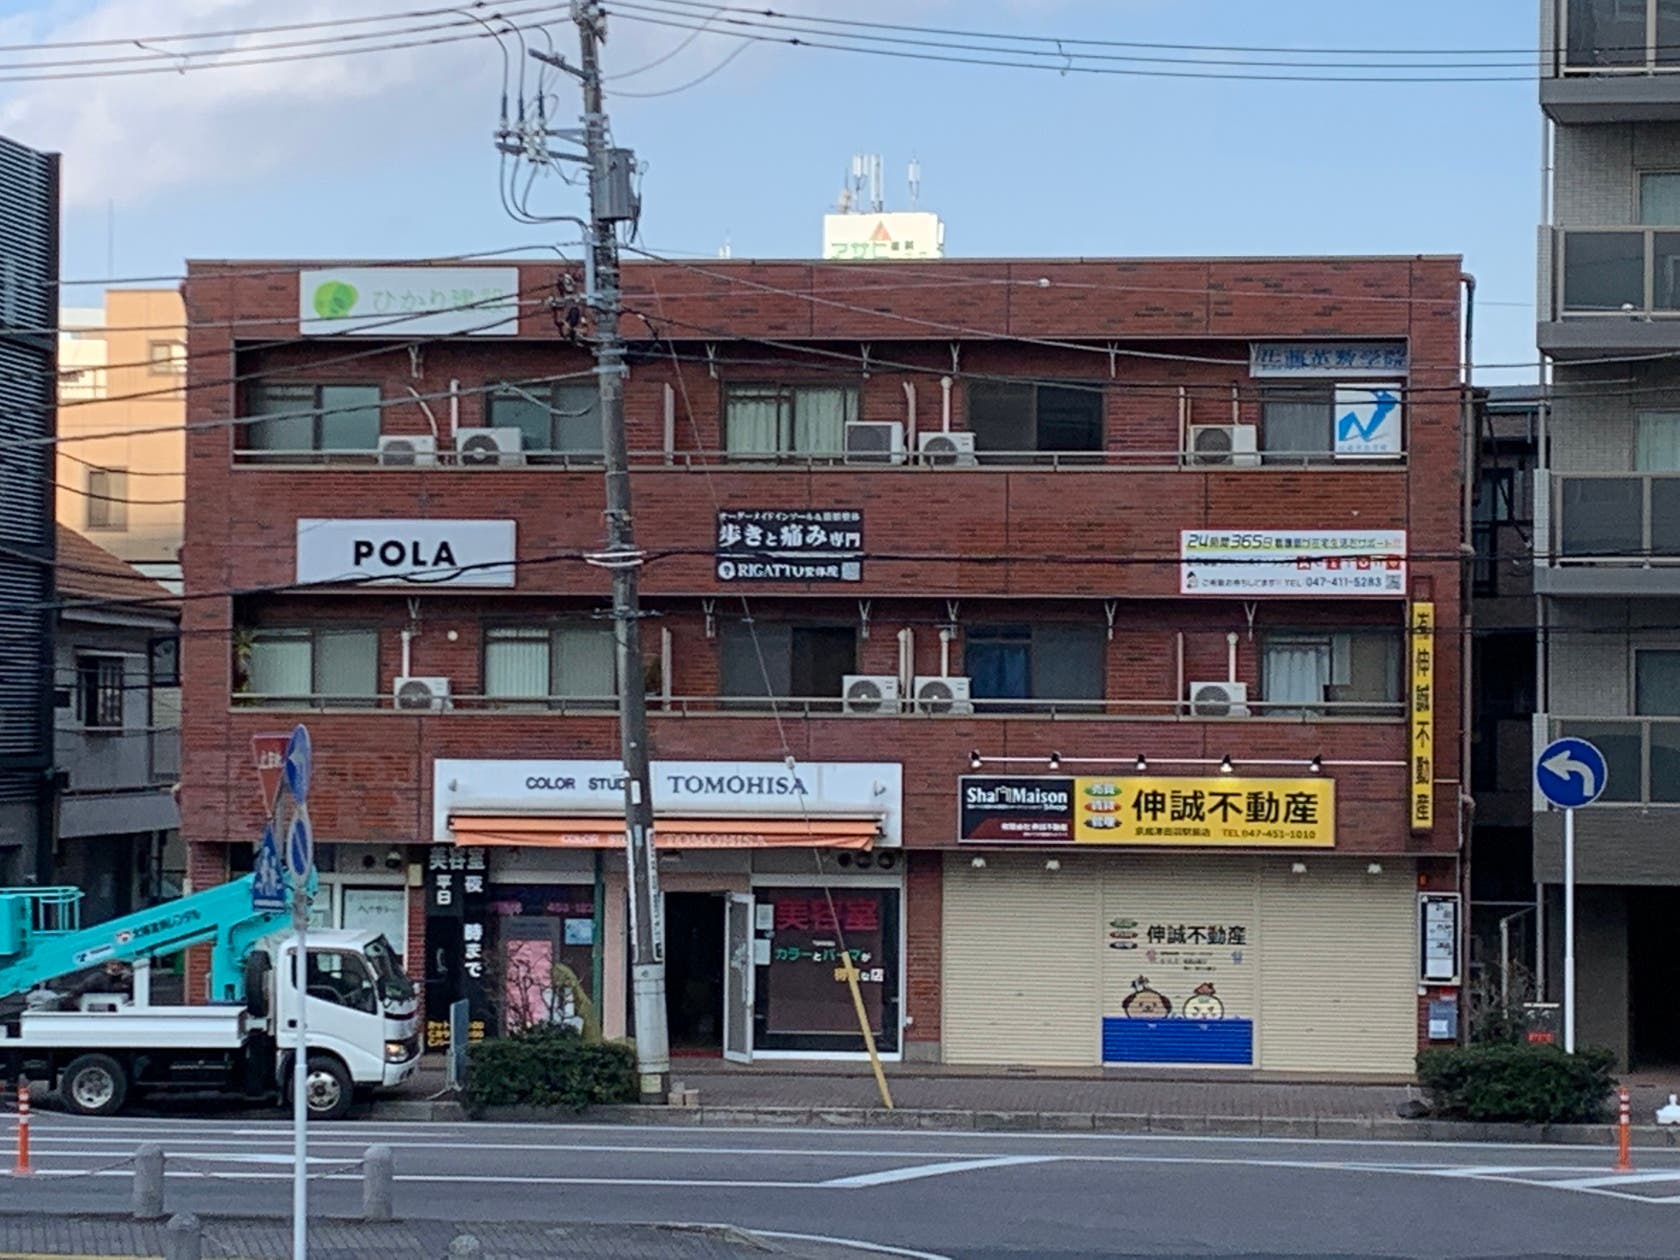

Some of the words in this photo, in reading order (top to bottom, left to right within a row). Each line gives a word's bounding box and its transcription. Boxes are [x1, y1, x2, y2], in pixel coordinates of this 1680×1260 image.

[719, 522, 861, 547] 歩きと痛み専門
[353, 539, 457, 567] POLA
[526, 777, 576, 790] COLOR
[588, 778, 626, 791] STUD
[667, 775, 808, 796] TOMOHISA
[1132, 789, 1318, 825] 伸誠不動産
[1222, 829, 1240, 838] TEL
[436, 874, 452, 905] 平日
[464, 875, 484, 893] 夜
[776, 899, 878, 930] 美容室
[1147, 924, 1246, 945] 伸誠不動産
[463, 923, 484, 978] 時まで
